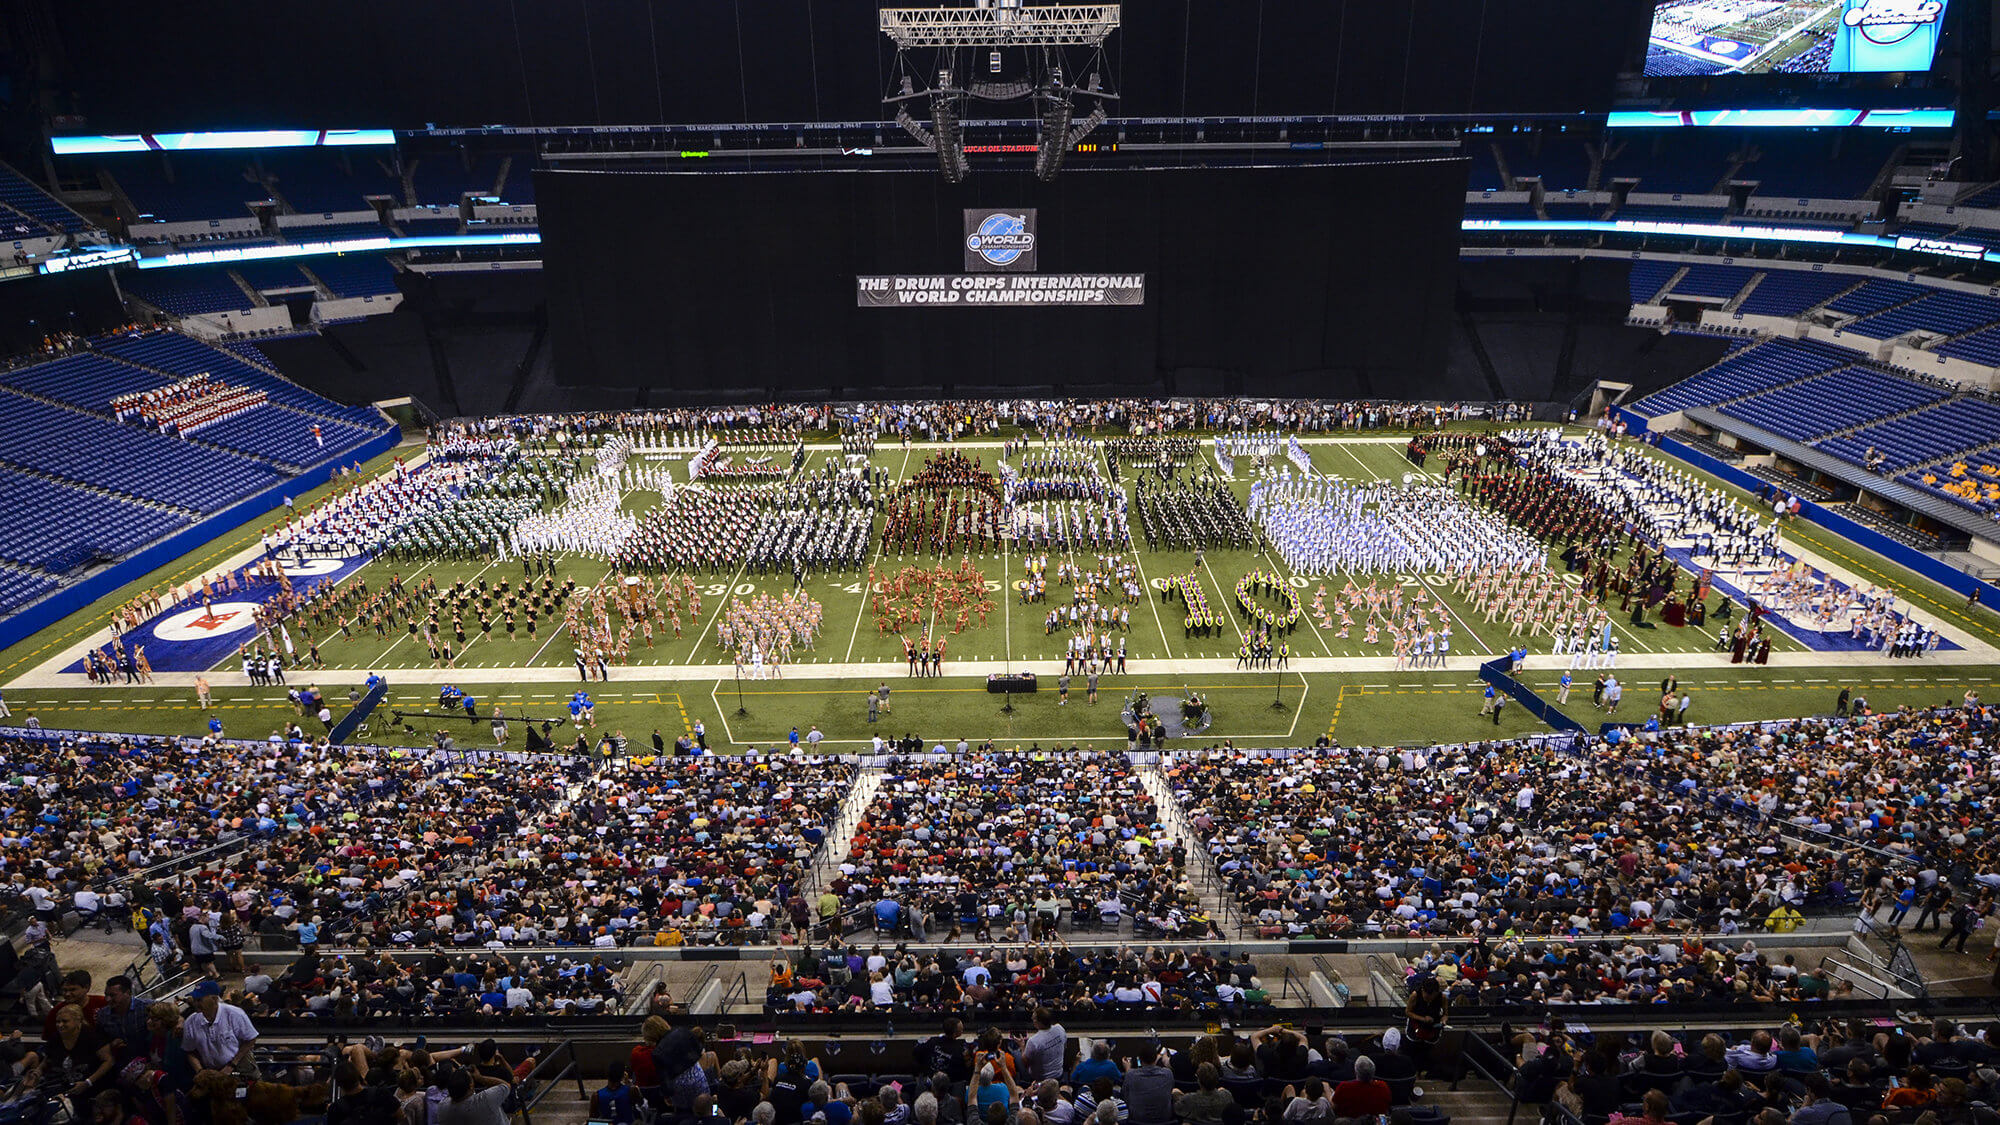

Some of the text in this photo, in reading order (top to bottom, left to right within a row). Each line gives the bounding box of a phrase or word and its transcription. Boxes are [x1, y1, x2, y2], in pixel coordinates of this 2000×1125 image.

[963, 144, 1039, 153] LUCAS OIL STADIUM
[981, 234, 1032, 244] WORLD
[859, 276, 1143, 290] THE DRUM CORPS INTERNATIONAL
[898, 290, 1105, 303] WORLD CHAMPIONSHIPS
[703, 583, 756, 596] 30
